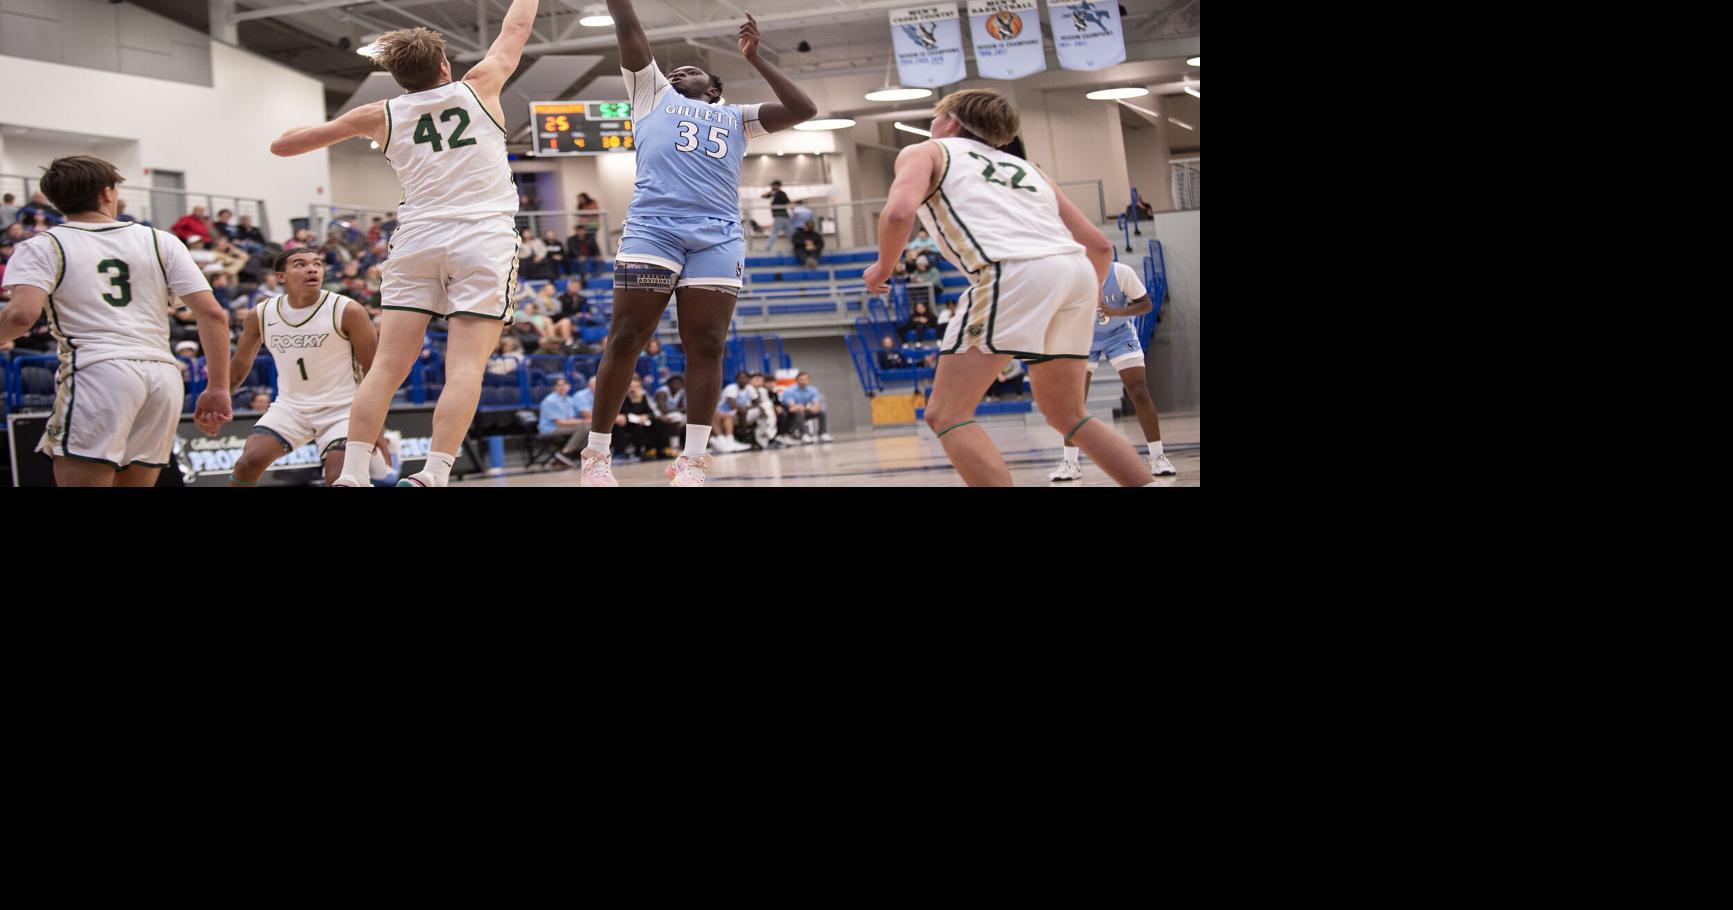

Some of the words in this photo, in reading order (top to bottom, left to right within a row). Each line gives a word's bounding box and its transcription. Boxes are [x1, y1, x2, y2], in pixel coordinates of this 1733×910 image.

[908, 7, 938, 16] MEN'S
[971, 1, 1032, 13] BASKETBALL
[413, 107, 477, 152] 42
[544, 115, 570, 132] 25
[665, 104, 739, 131] GILLETTE
[674, 120, 730, 160] 35
[968, 151, 1038, 193] 22
[97, 258, 132, 307] 3
[271, 333, 330, 354] ROCKY
[296, 357, 308, 381] 1
